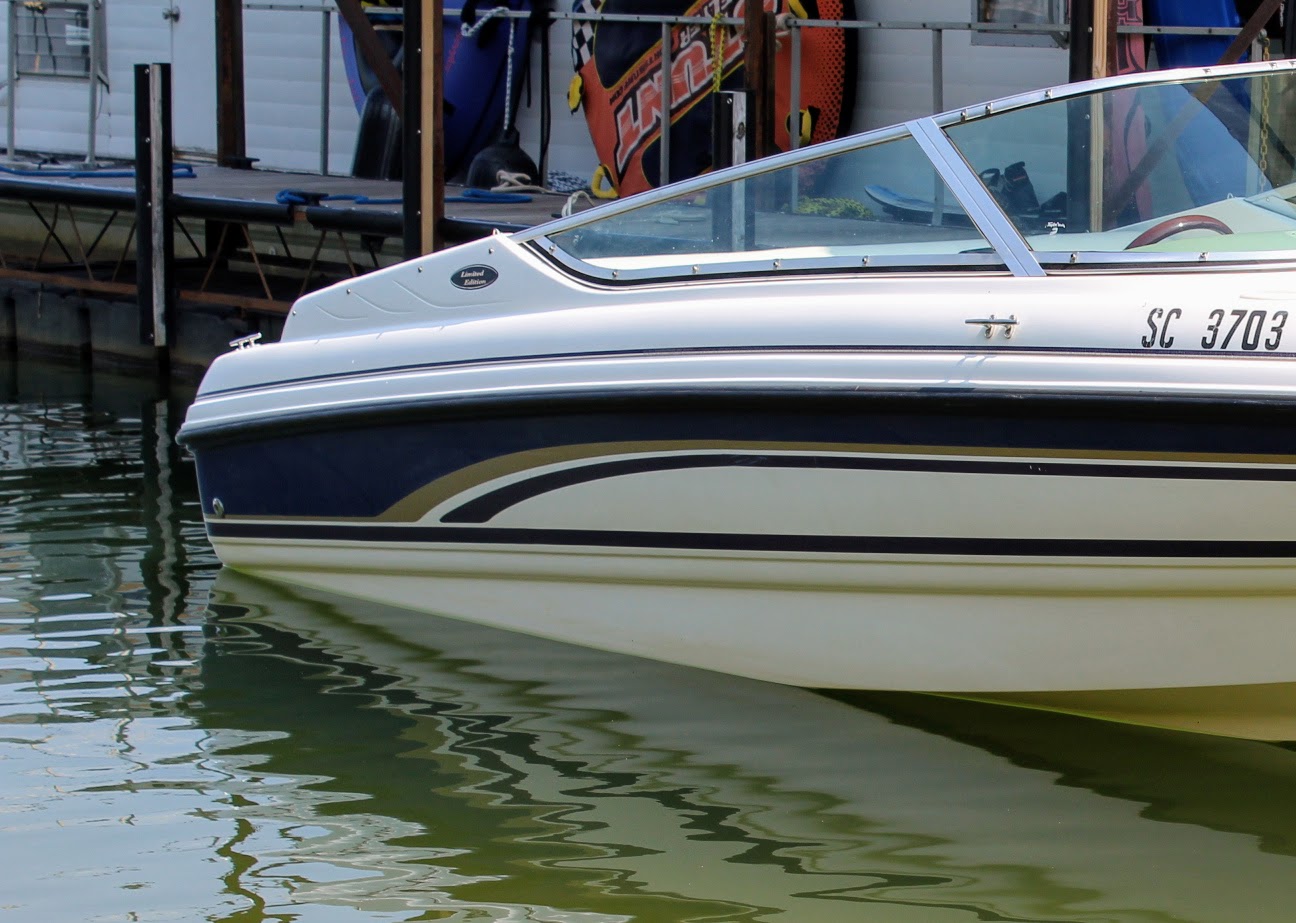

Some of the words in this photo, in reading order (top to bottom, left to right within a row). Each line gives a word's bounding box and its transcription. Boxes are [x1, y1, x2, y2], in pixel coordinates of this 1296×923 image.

[461, 270, 485, 278] Limited
[1141, 308, 1182, 348] SC
[1200, 309, 1289, 351] 3703
